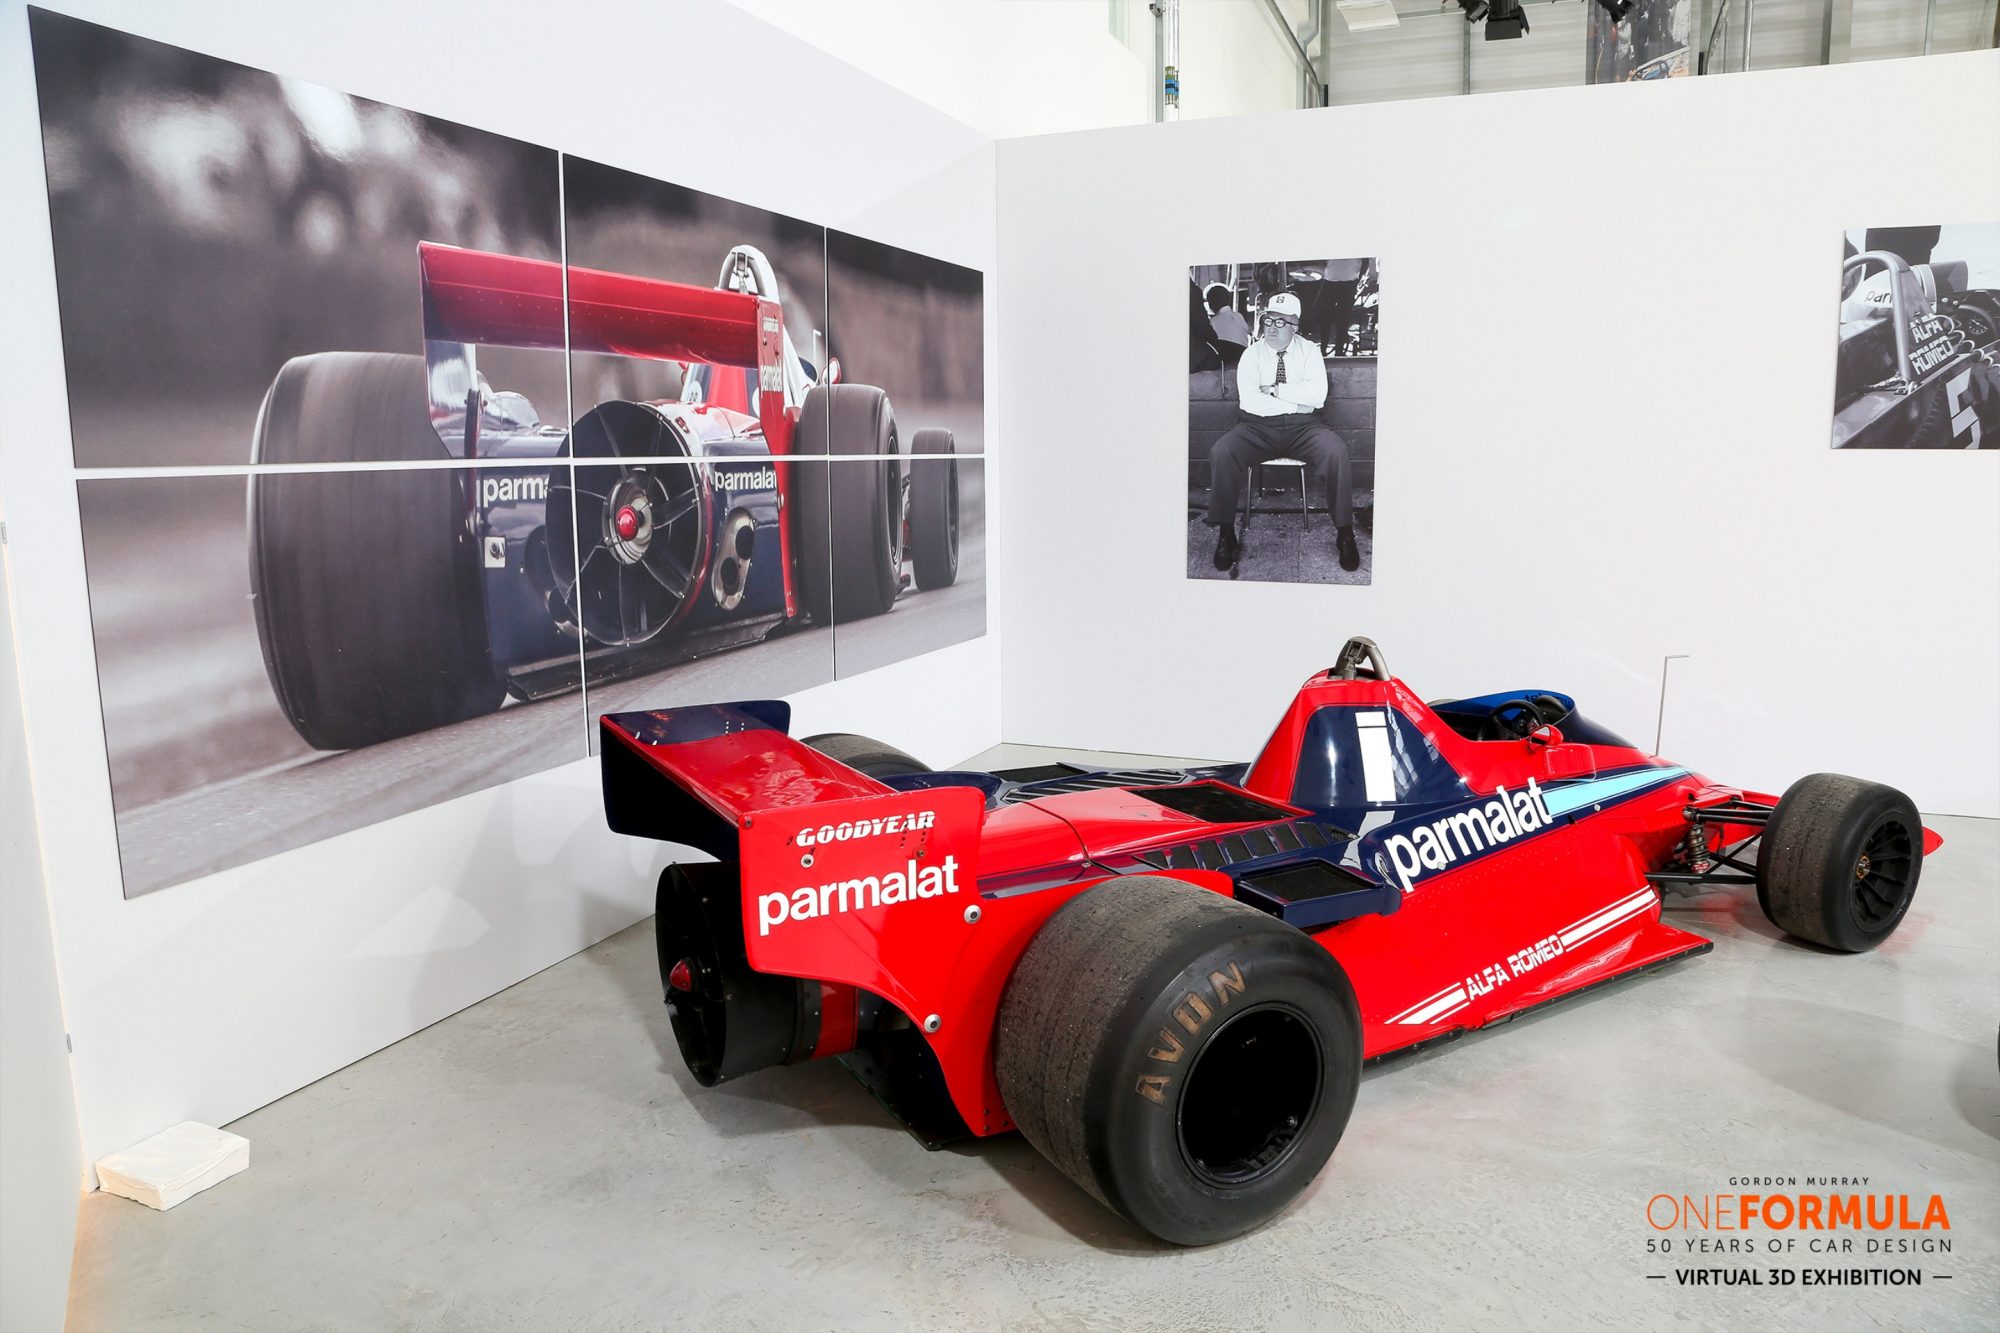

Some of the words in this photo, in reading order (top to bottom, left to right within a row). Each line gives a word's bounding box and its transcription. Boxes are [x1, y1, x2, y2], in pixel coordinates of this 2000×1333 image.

[1909, 335, 1956, 376] ROMEO
[1910, 313, 1943, 344] ALFA
[796, 810, 936, 847] GOODYEAR
[1384, 776, 1552, 893] parmalat
[758, 855, 959, 937] parmalat
[1466, 963, 1511, 1001] ALFA
[1507, 934, 1564, 978] ROMEO
[1135, 961, 1247, 1106] AVON
